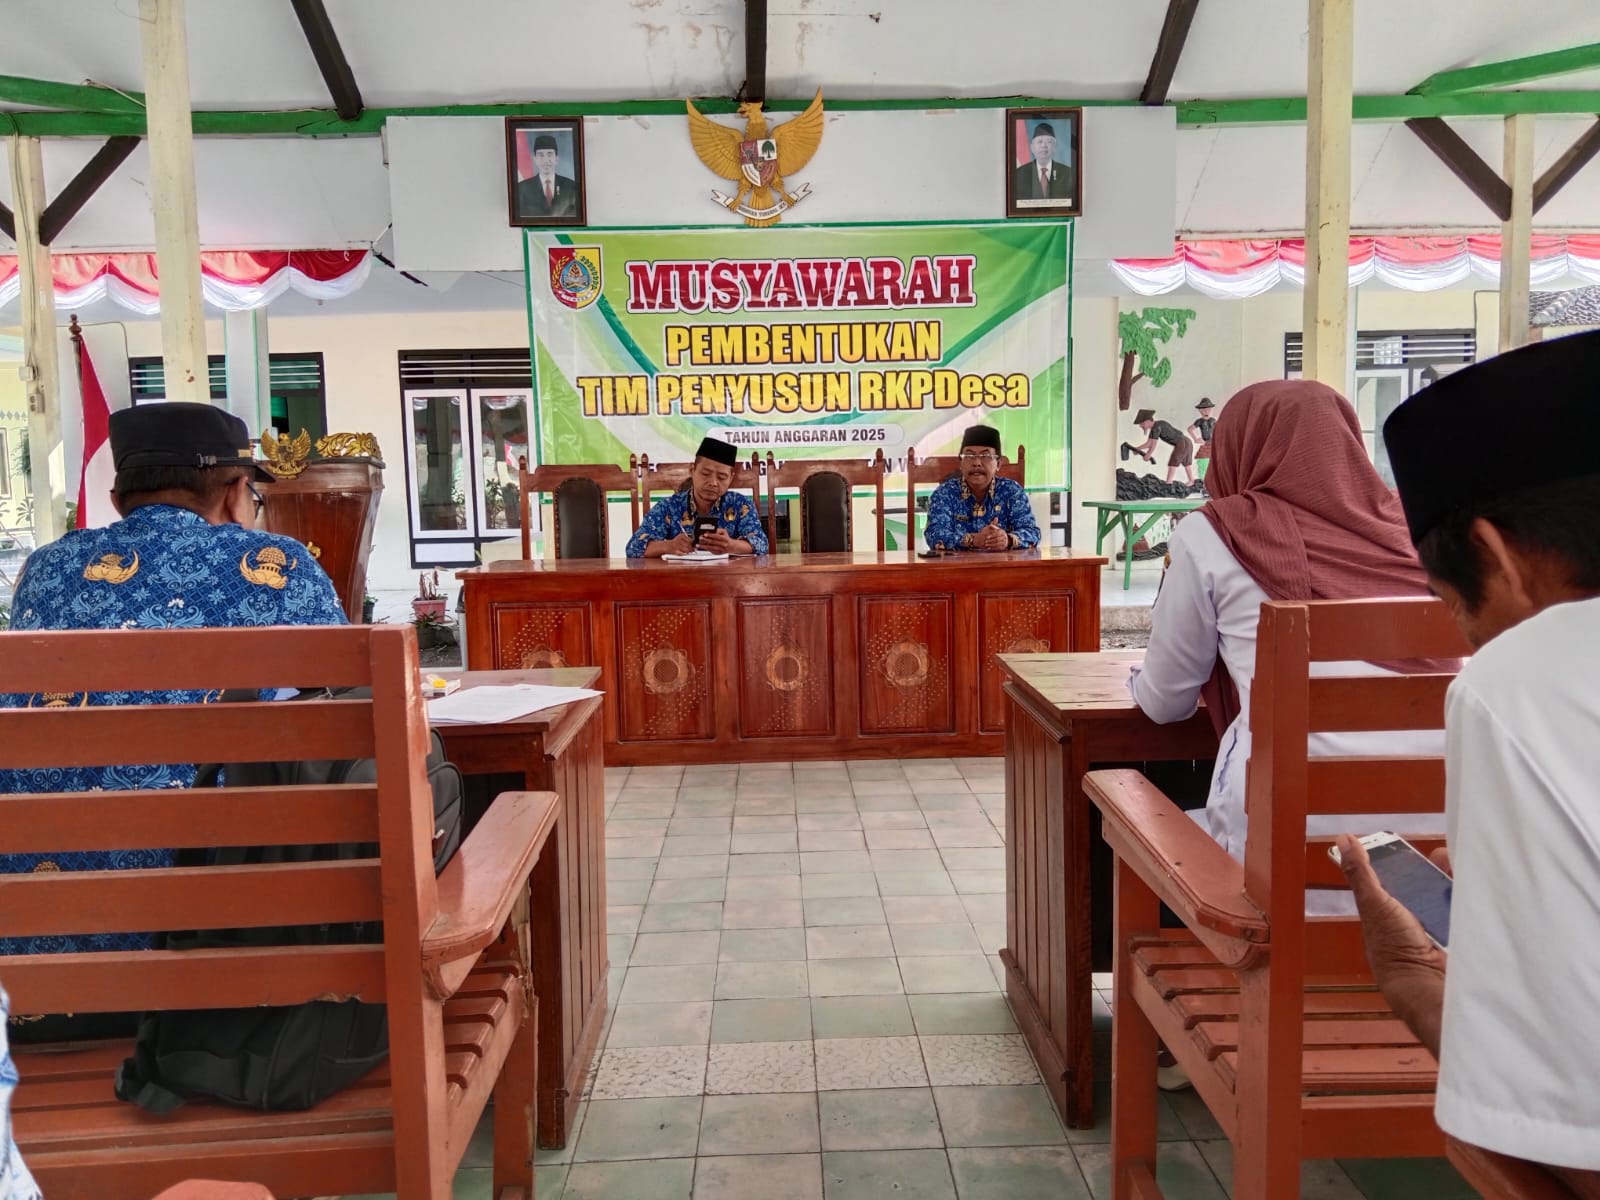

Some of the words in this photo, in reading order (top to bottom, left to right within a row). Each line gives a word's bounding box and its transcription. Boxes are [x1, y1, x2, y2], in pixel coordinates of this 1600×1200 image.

[628, 258, 974, 311] MUSYAWARAH
[665, 320, 941, 366] PEMBENTUKAN
[576, 375, 650, 416] TIM
[656, 372, 850, 415] PENYUSUN
[858, 369, 1030, 411] RKPDesa
[725, 431, 770, 444] TAHUN
[774, 429, 847, 442] ANGGARAN
[851, 428, 886, 441] 2025
